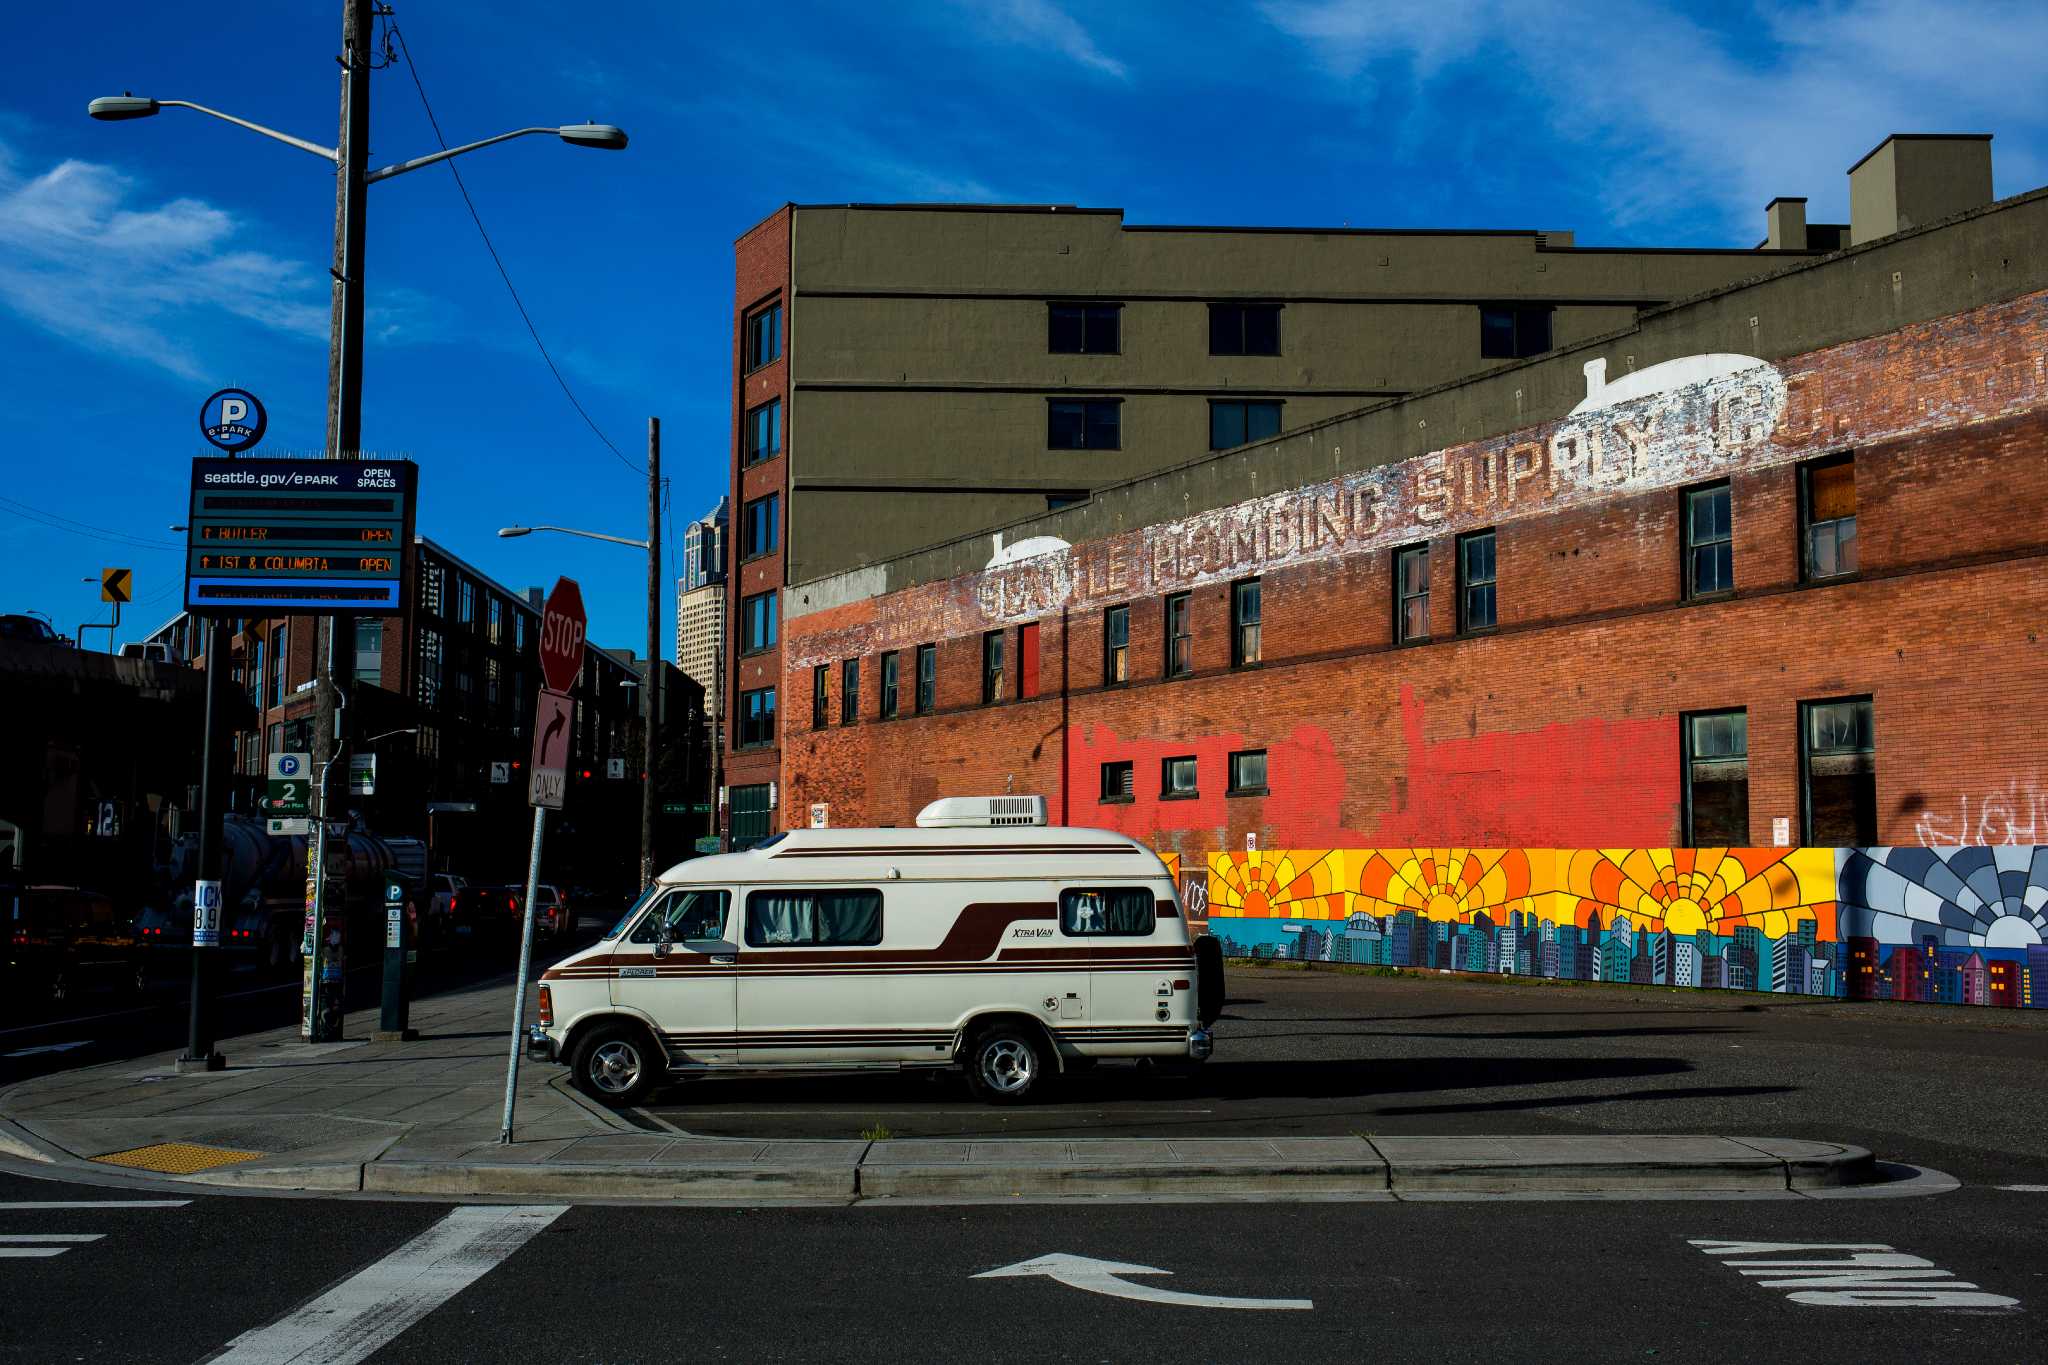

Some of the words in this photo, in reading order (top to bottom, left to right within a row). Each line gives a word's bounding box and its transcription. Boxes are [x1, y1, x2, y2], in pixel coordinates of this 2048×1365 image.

[363, 468, 391, 478] OPEN
[1407, 405, 1665, 524] SUPPLY
[357, 478, 396, 488] SPACES
[219, 527, 268, 540] BUTLER
[361, 529, 393, 542] OPEN
[219, 556, 241, 569] 1ST
[249, 556, 257, 569] &
[264, 556, 328, 571] COLUMBIA
[360, 558, 392, 572] OPEN
[544, 610, 583, 659] STOP
[282, 783, 297, 801] 2
[534, 773, 561, 798] ONLY
